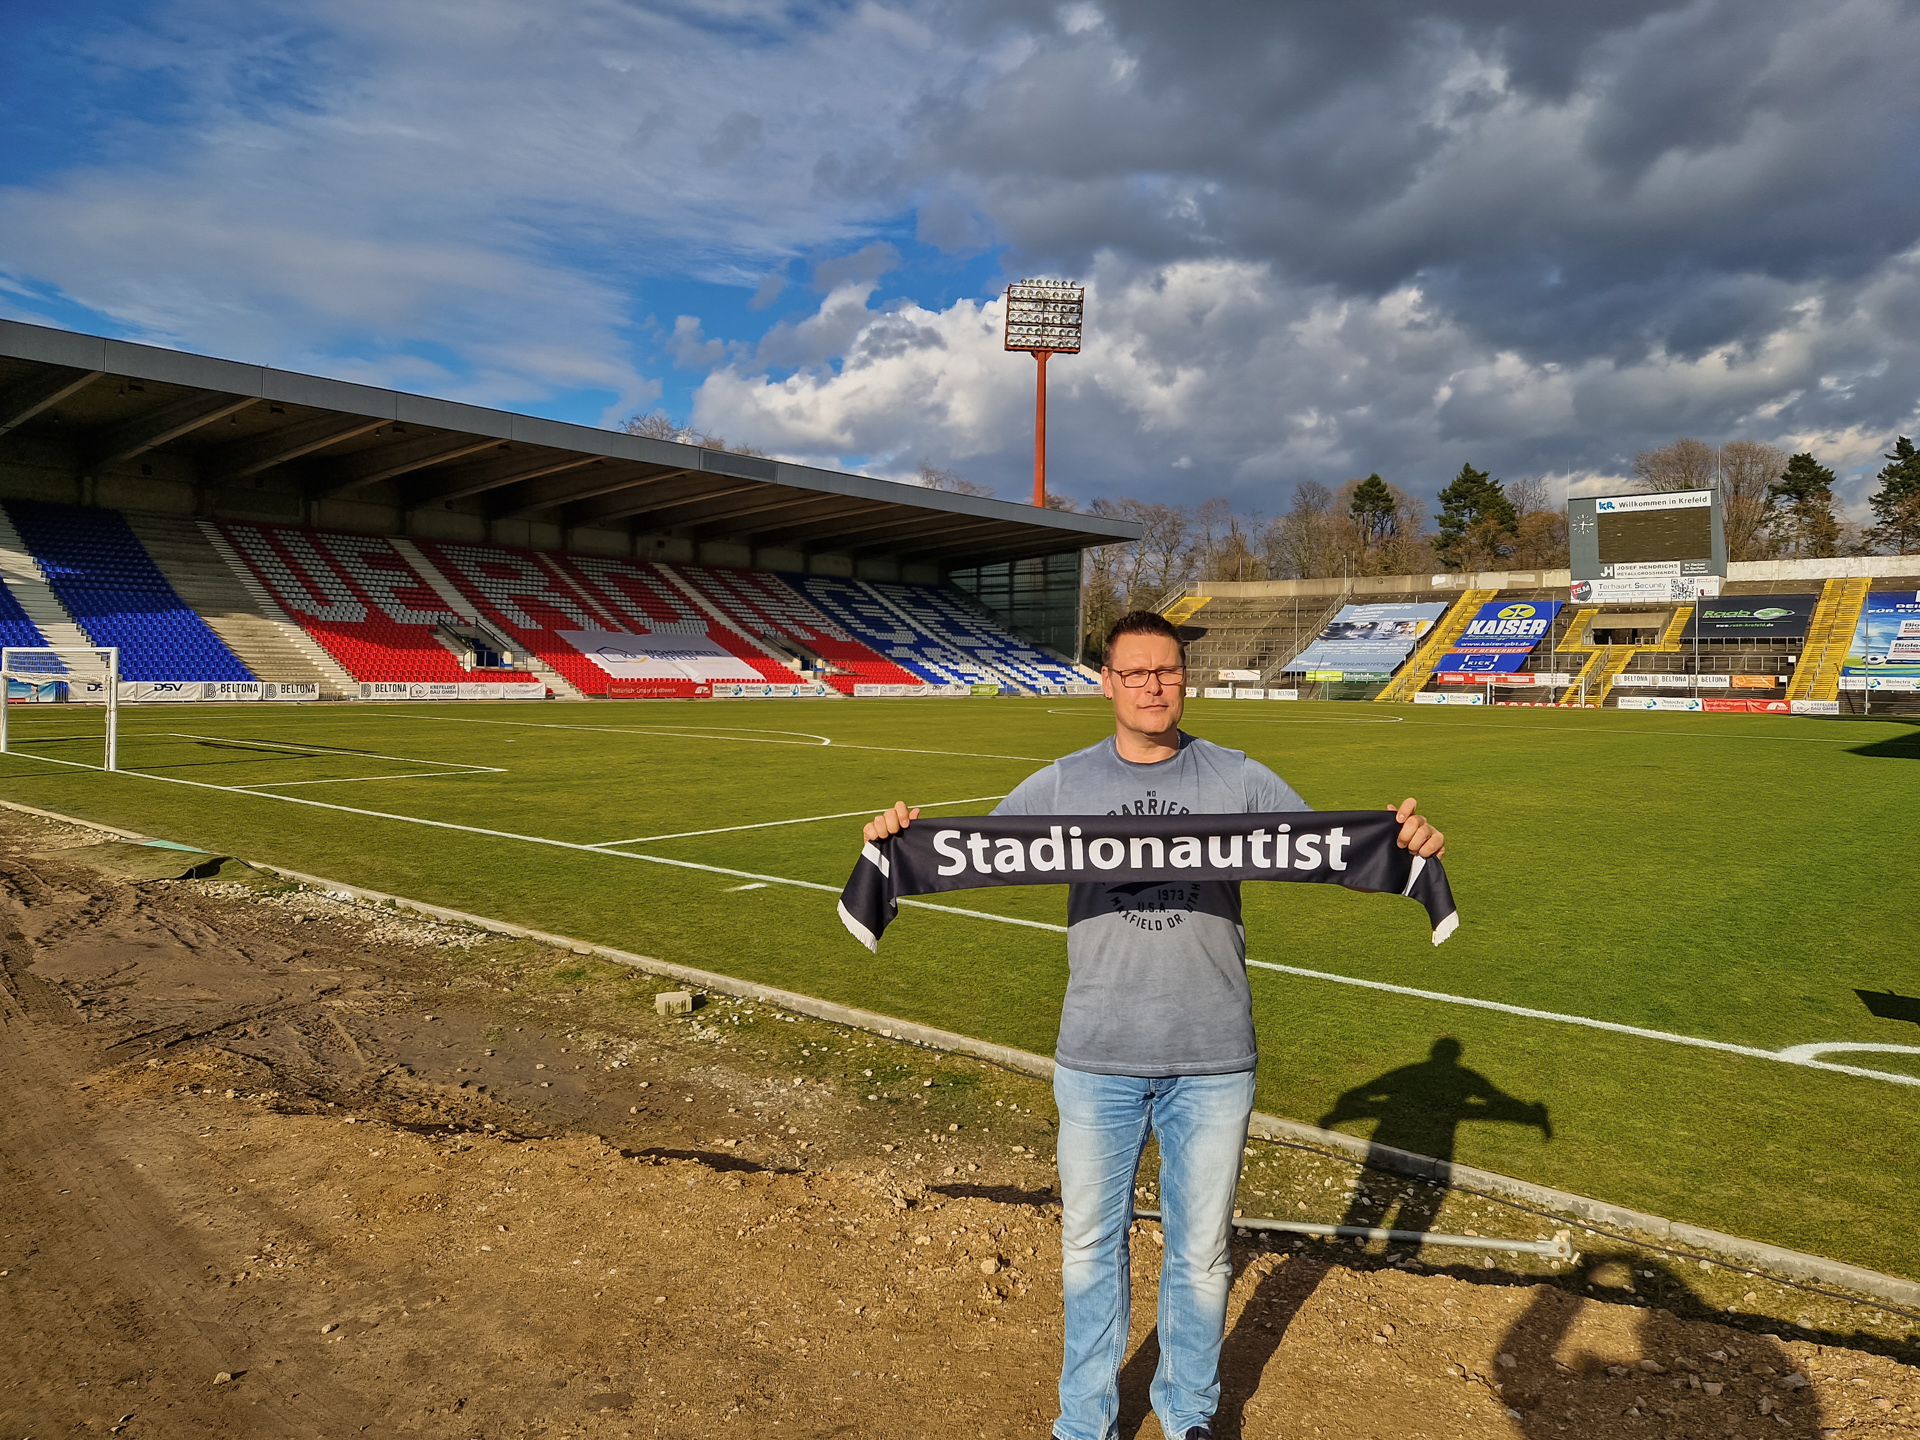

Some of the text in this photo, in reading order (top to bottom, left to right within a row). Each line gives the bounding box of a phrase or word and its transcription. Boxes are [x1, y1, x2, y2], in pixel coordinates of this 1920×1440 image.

[1599, 501, 1615, 511] KR
[1619, 499, 1667, 508] Willkommen
[1679, 496, 1708, 504] Krefeld
[1634, 582, 1667, 590] Security
[1466, 619, 1547, 635] KAISER
[87, 683, 104, 692] DS
[154, 683, 183, 692] DSV
[220, 683, 259, 693] BELTONA
[280, 684, 316, 694] BELTONA
[374, 683, 407, 693] BELTONA
[932, 823, 1351, 876] Stadionautist
[1157, 889, 1184, 901] 1973
[1110, 883, 1201, 931] MAXFIELD DR. UTAH
[1137, 902, 1170, 913] U.S.A.
